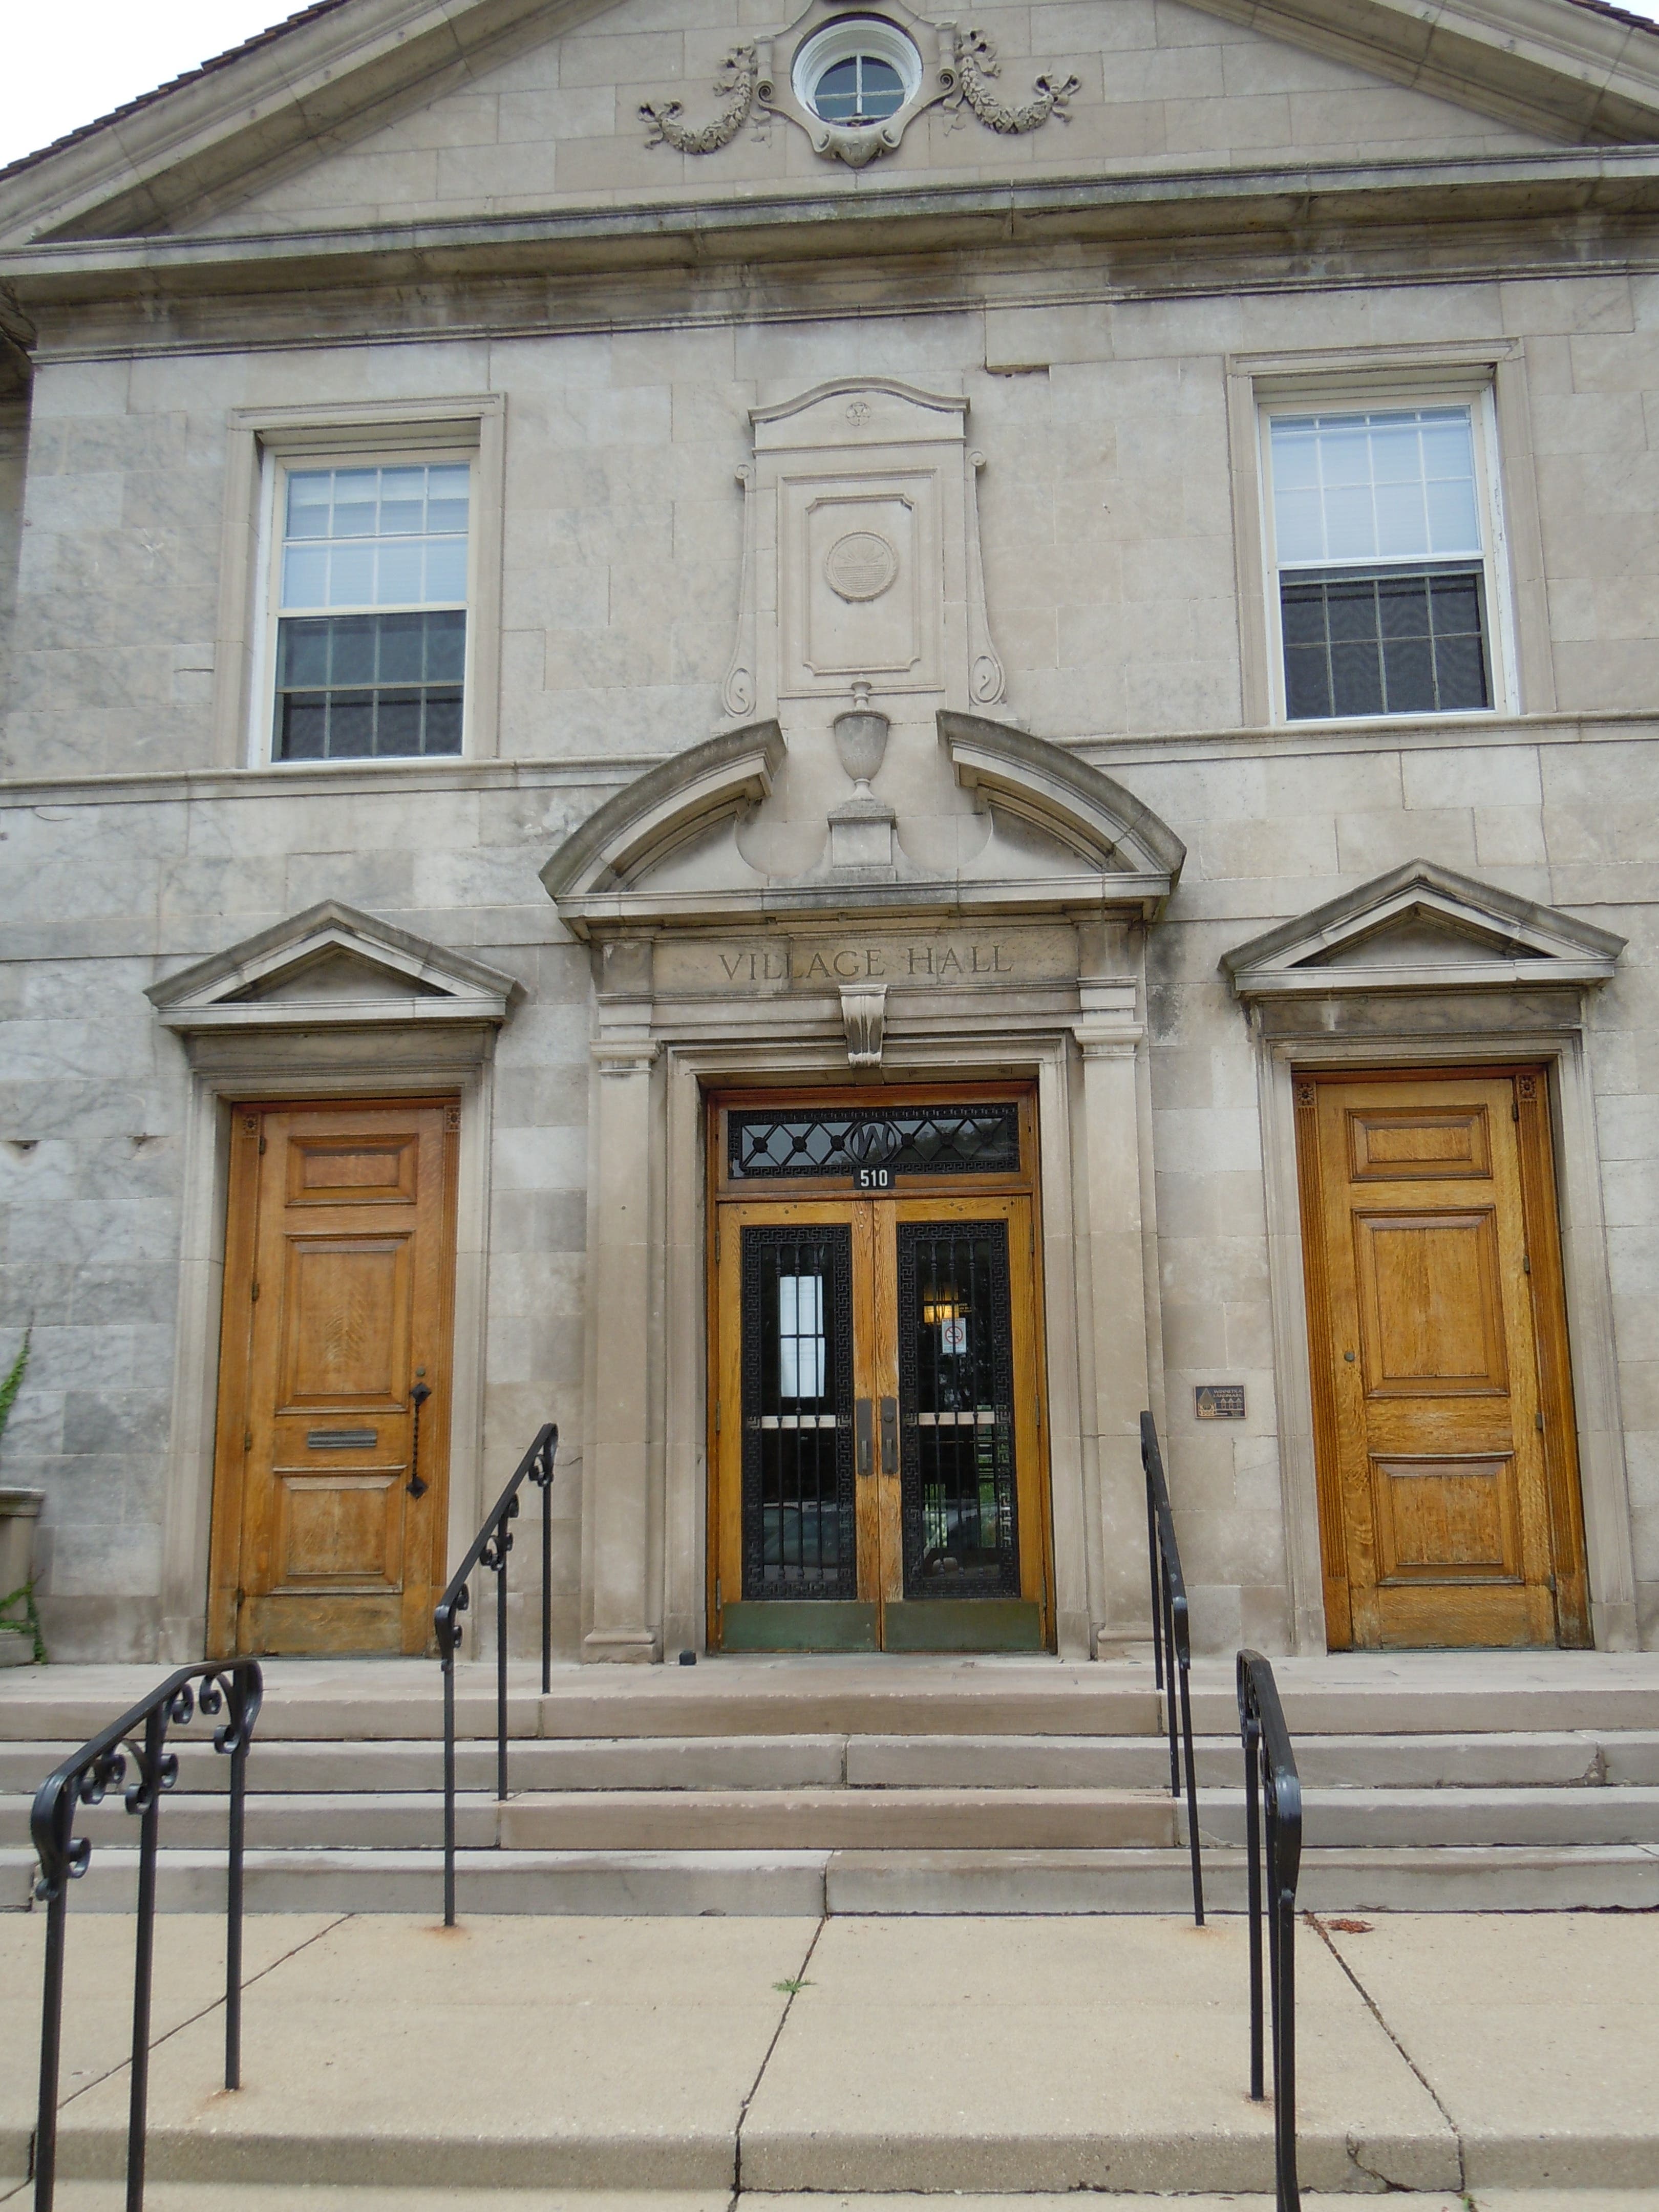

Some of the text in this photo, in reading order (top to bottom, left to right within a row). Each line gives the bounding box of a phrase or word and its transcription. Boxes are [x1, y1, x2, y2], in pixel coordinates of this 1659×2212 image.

[718, 945, 1013, 980] VILLAGE HALL
[860, 1169, 888, 1187] 510
